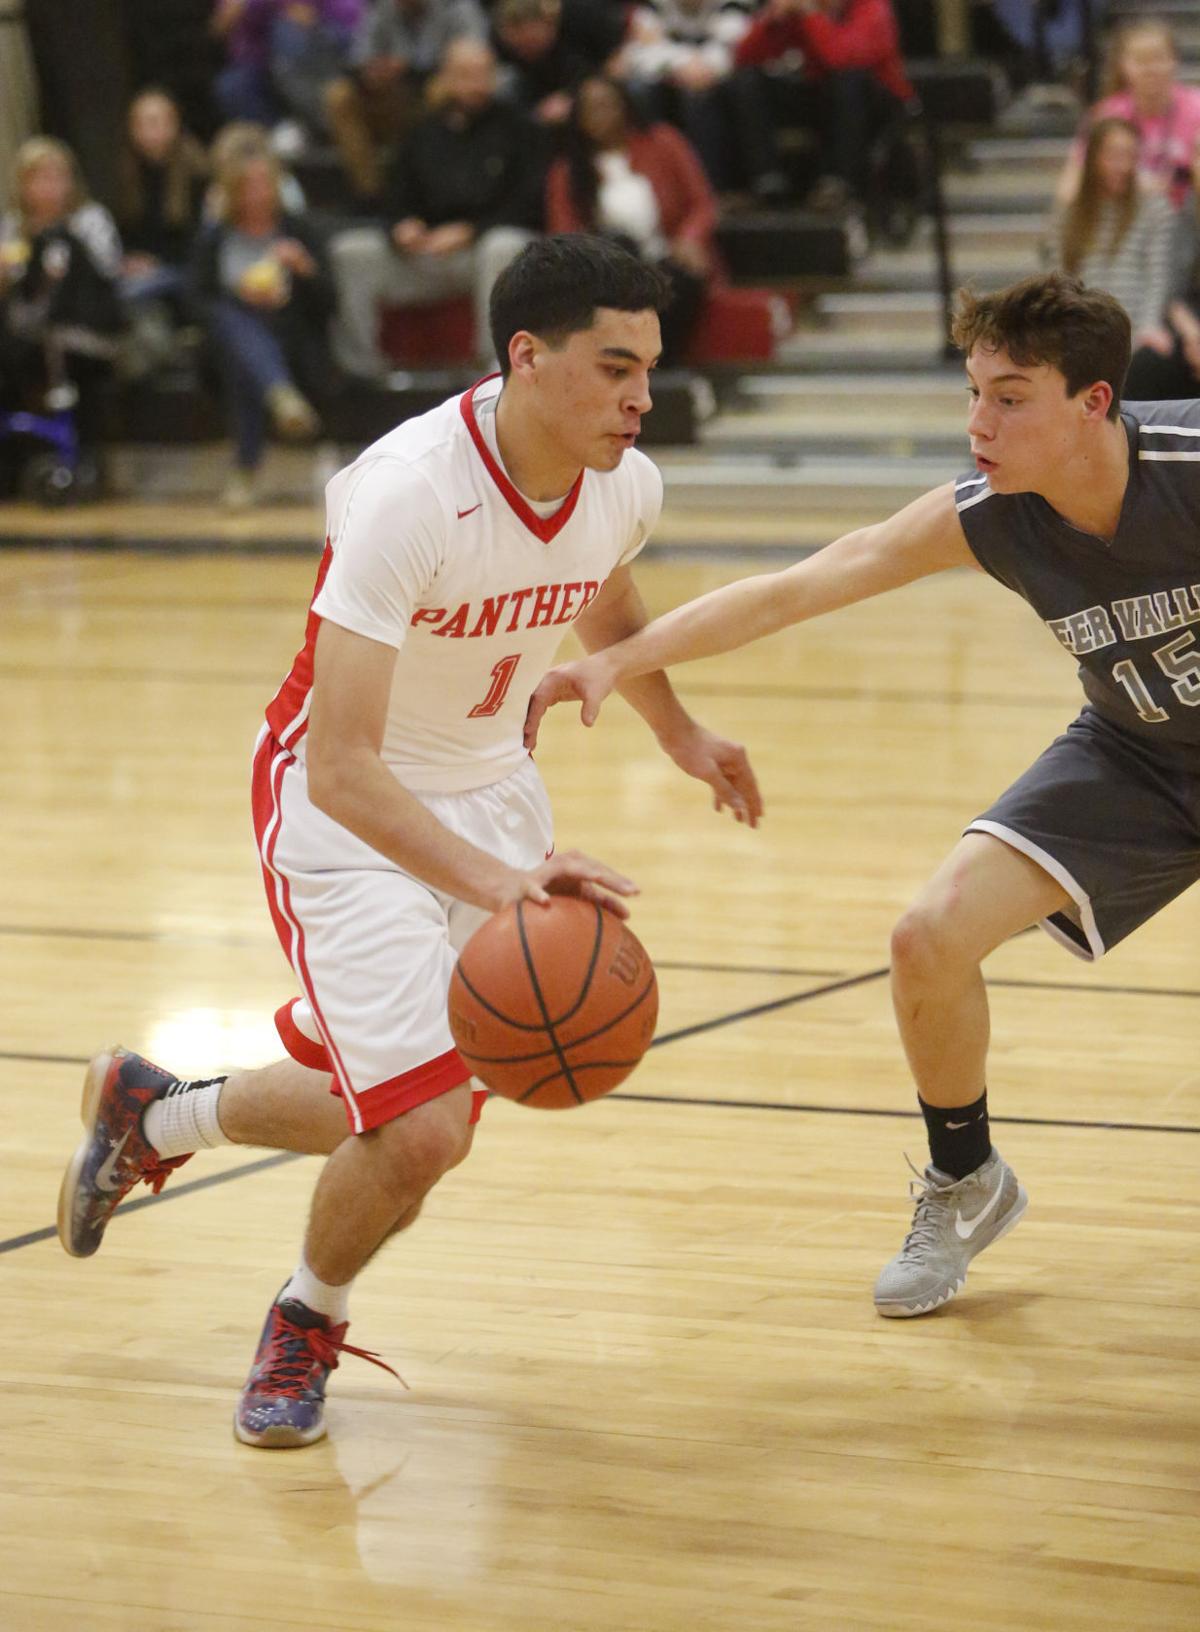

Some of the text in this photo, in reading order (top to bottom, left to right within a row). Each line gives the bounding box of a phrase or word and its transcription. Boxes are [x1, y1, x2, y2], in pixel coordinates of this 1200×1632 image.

[410, 579, 607, 638] PANTHER
[466, 652, 522, 719] 1
[1112, 629, 1200, 722] 15
